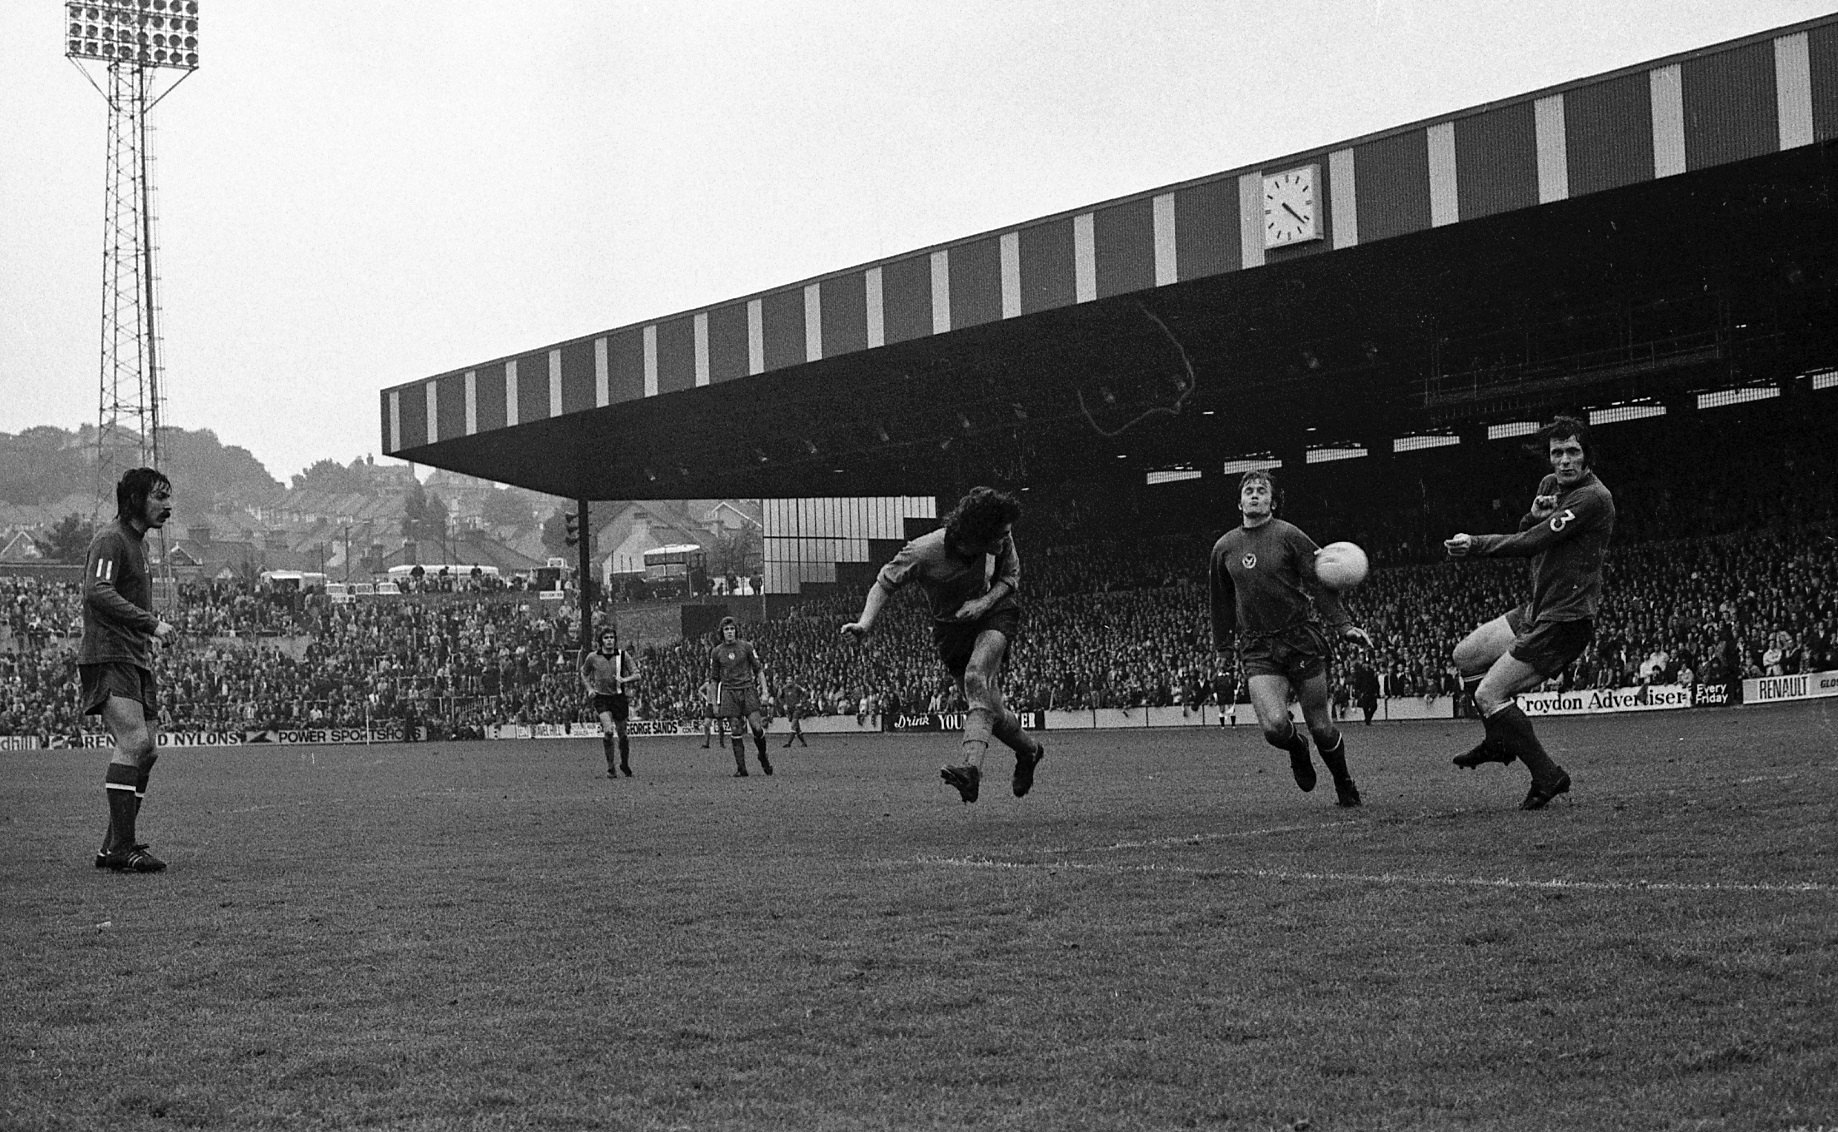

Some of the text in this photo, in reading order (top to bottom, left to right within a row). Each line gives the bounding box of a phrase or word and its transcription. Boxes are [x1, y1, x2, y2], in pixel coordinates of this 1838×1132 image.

[1550, 509, 1576, 532] 3
[96, 558, 113, 580] 11
[1697, 684, 1727, 695] Every
[1759, 676, 1808, 699] RENAULT
[1695, 692, 1729, 705] Friday
[652, 721, 678, 733] SANDS
[894, 713, 930, 728] Drink
[174, 732, 239, 746] NYLONS
[279, 728, 422, 743] POWER SPORTSHOS
